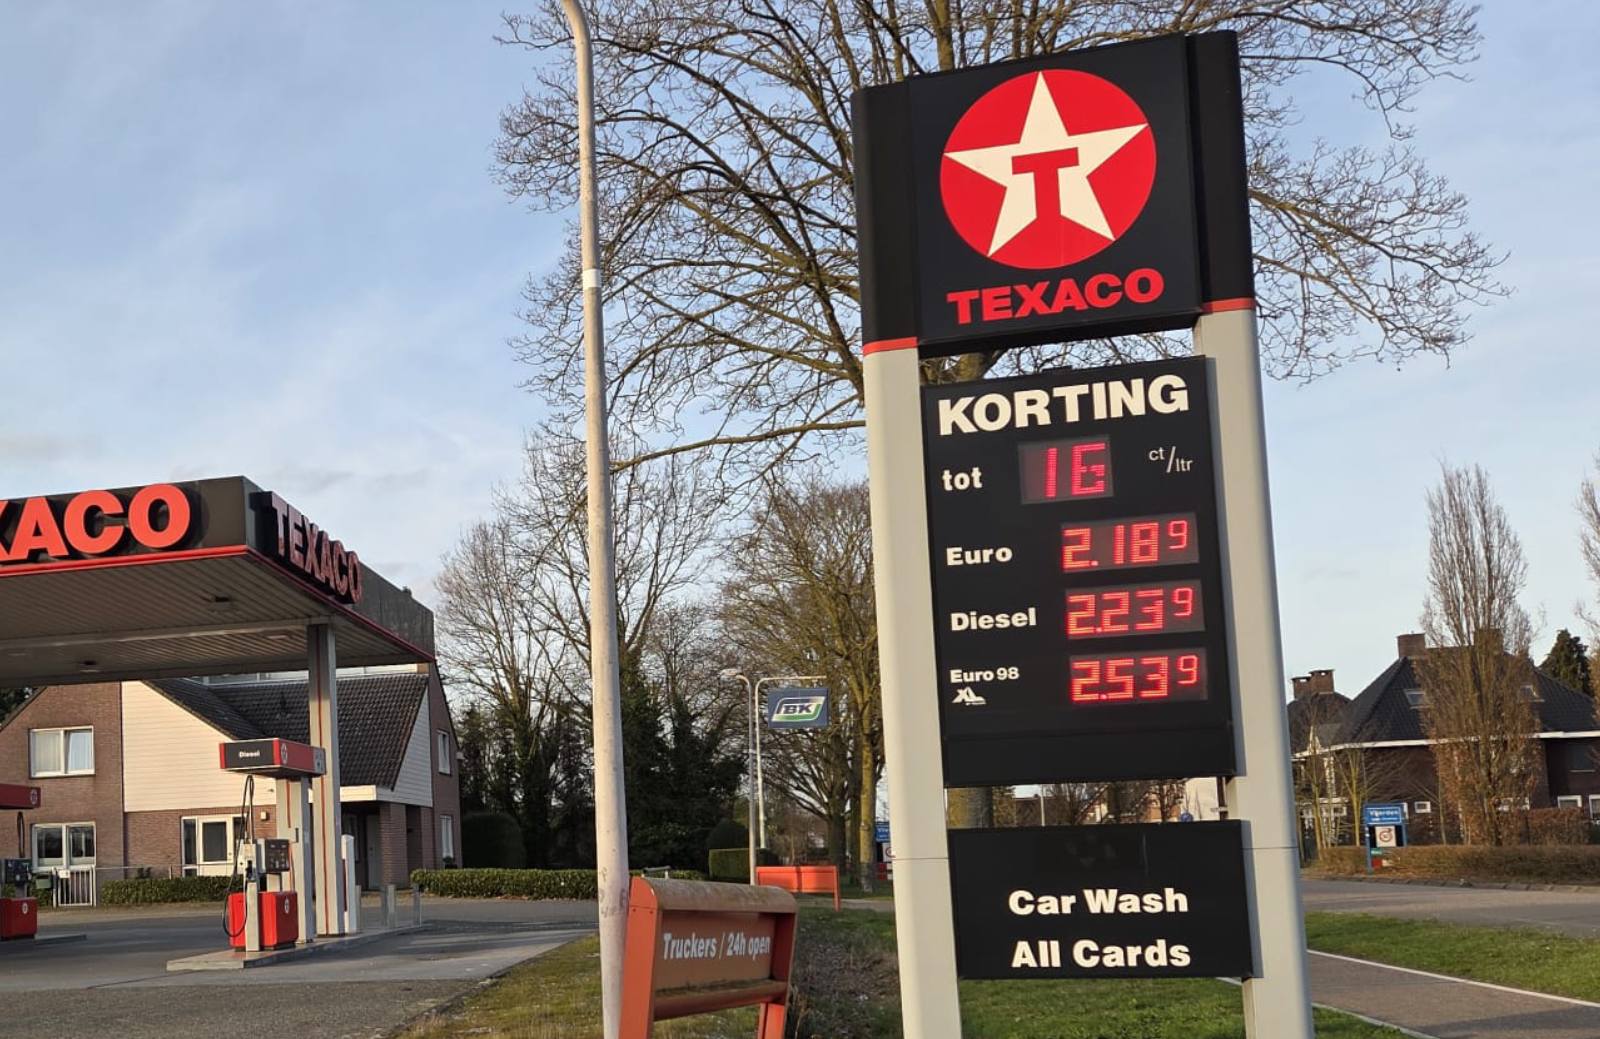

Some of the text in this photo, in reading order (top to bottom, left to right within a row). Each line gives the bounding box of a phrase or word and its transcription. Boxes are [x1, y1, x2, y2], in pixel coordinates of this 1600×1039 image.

[1012, 147, 1079, 218] T
[947, 268, 1165, 324] TEXACO
[938, 375, 1189, 436] KORTING
[941, 467, 983, 491] tot
[1045, 442, 1107, 498] 16
[0, 483, 191, 561] ACO
[271, 492, 362, 604] TEXACO
[946, 546, 1013, 566] Euro
[951, 607, 1037, 632] Diesel
[950, 668, 994, 684] Euro
[996, 666, 1020, 681] 98
[1007, 887, 1189, 916] Car Wash
[664, 933, 717, 960] Truckers
[727, 932, 746, 957] 24h
[748, 936, 771, 960] open
[1011, 939, 1191, 969] All Cards
